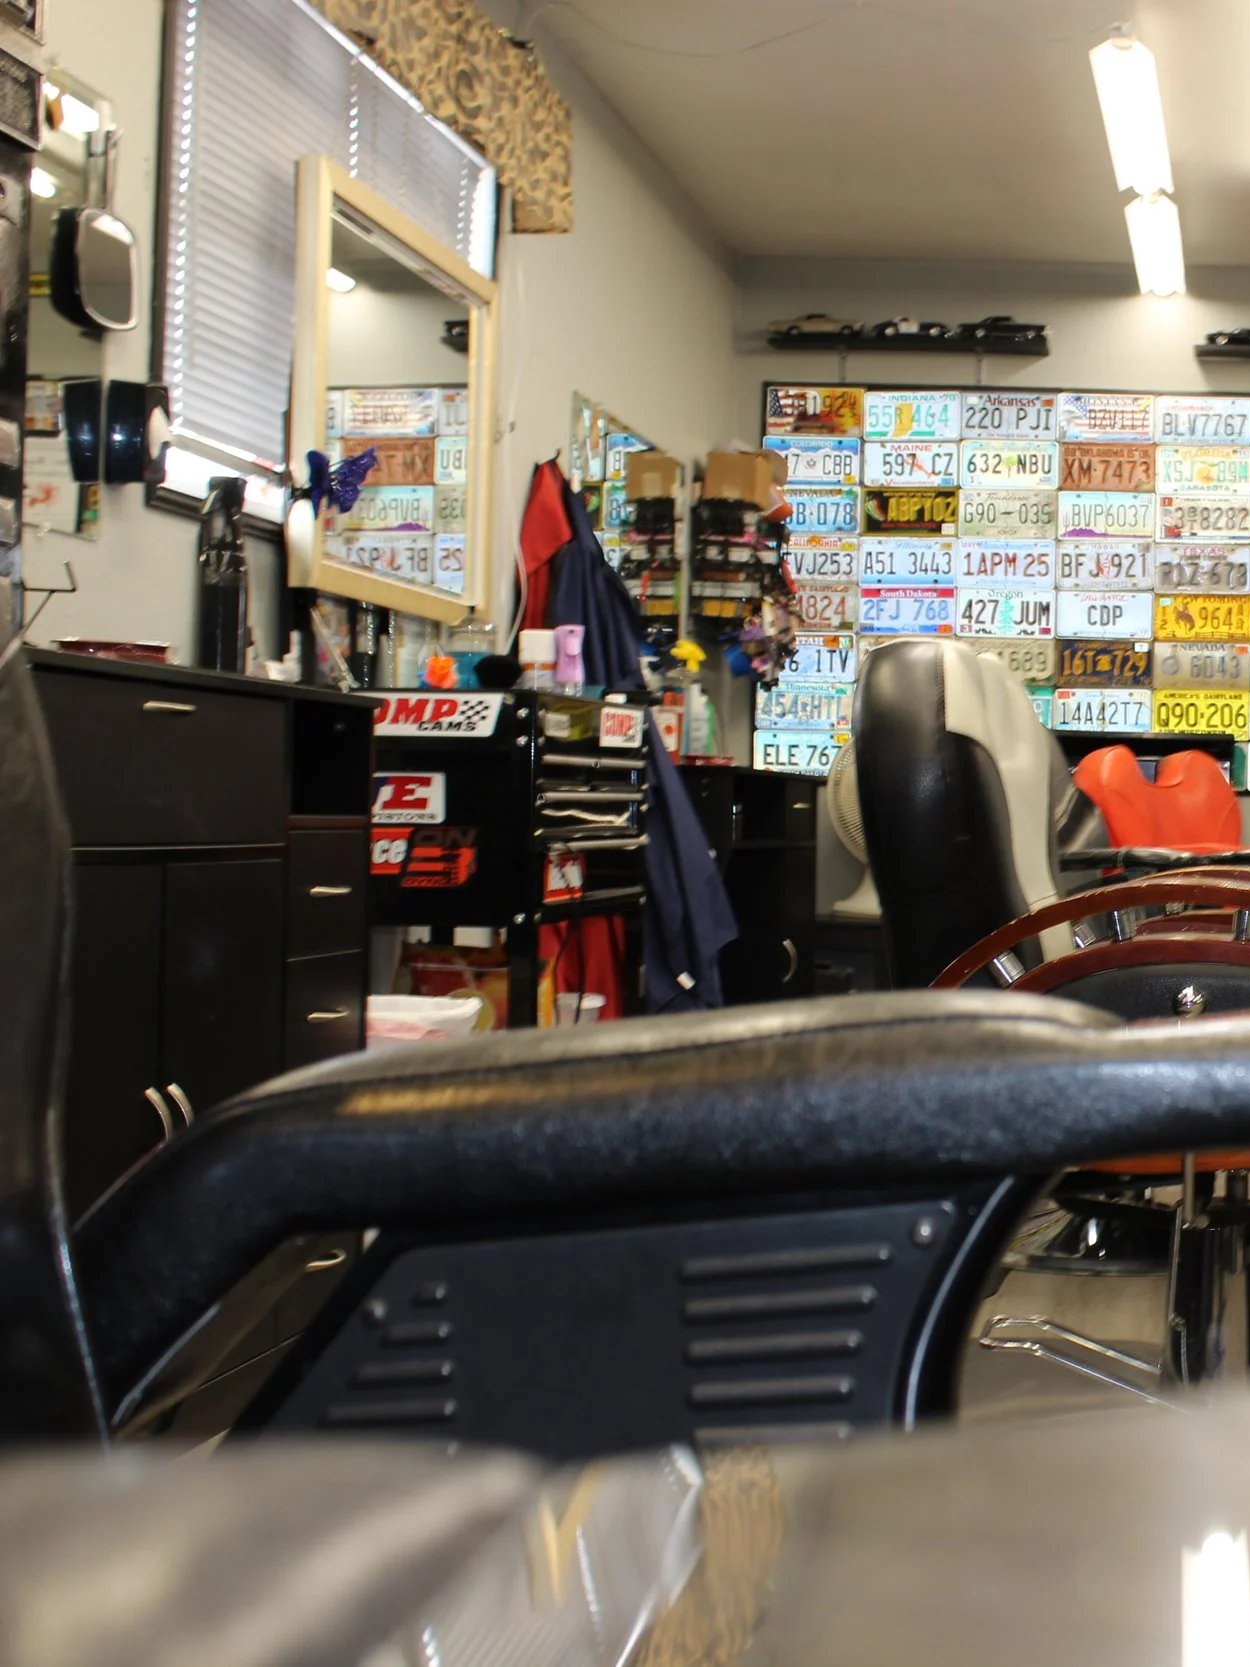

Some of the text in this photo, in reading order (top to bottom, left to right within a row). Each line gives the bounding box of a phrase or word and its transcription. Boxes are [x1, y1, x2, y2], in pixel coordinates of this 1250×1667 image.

[983, 394, 1036, 407] Arkansas
[965, 407, 1052, 430] 220 PJI
[1161, 412, 1247, 437] BLV7767
[823, 454, 853, 476] CBB
[883, 453, 953, 476] 597 CZ
[967, 454, 1052, 475] 632 NBU
[964, 502, 1052, 524] G90 035
[1072, 504, 1149, 527] BVP6037
[1183, 545, 1227, 555] TEXAS
[864, 552, 951, 576] A51 3443
[963, 552, 1050, 577] 1APM 25
[1061, 554, 1146, 578] BFJ 921
[880, 589, 937, 598] South Dakota
[988, 589, 1023, 599] Oregon
[863, 599, 949, 621] 2FJ 768
[961, 599, 1050, 626] 427 JUM
[1088, 605, 1122, 627] CDP
[1199, 606, 1232, 630] 964
[1180, 643, 1225, 651] NEVADA
[816, 650, 849, 673] 1TV
[786, 683, 829, 691] Minnesota
[1060, 702, 1145, 725] 14A42T7
[417, 720, 478, 732] CAMS
[764, 744, 799, 766] ELE
